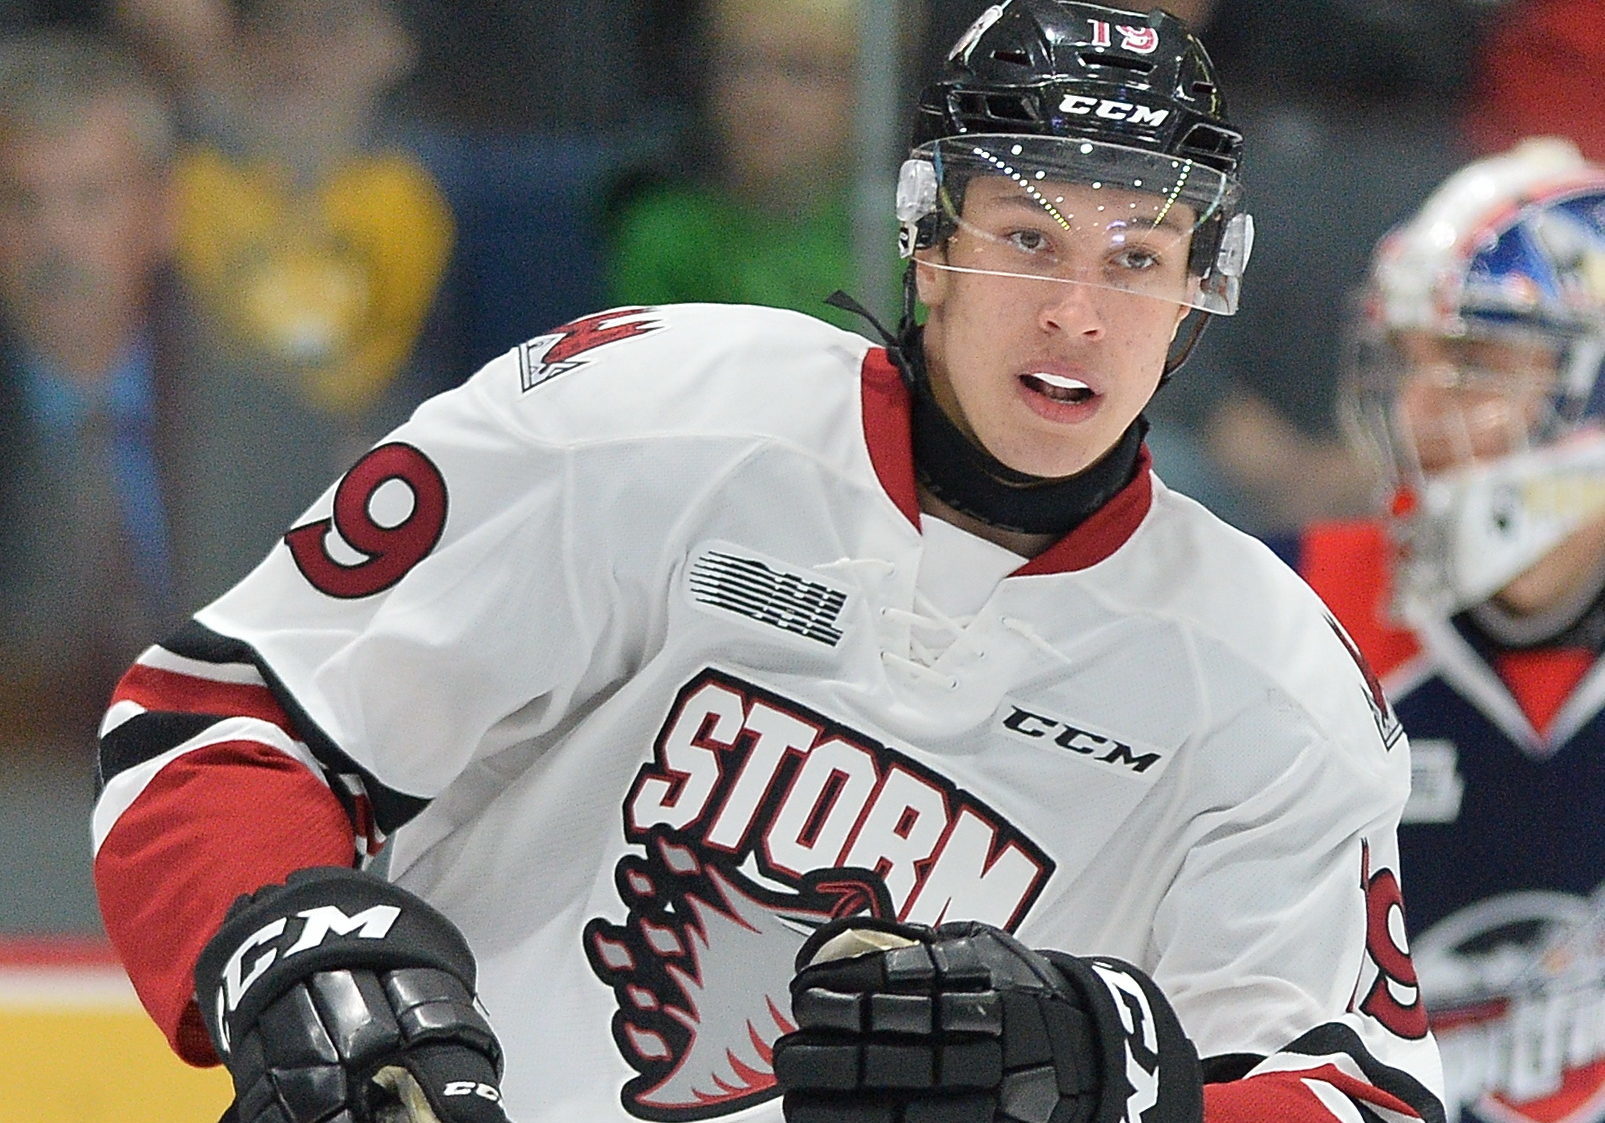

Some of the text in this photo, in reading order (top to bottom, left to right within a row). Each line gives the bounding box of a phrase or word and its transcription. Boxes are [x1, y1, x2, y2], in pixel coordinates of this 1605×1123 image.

[1087, 19, 1159, 54] 19
[1058, 94, 1169, 127] CCM
[1002, 705, 1162, 774] CCM
[624, 672, 1052, 930] STORM
[443, 1081, 504, 1109] CC
